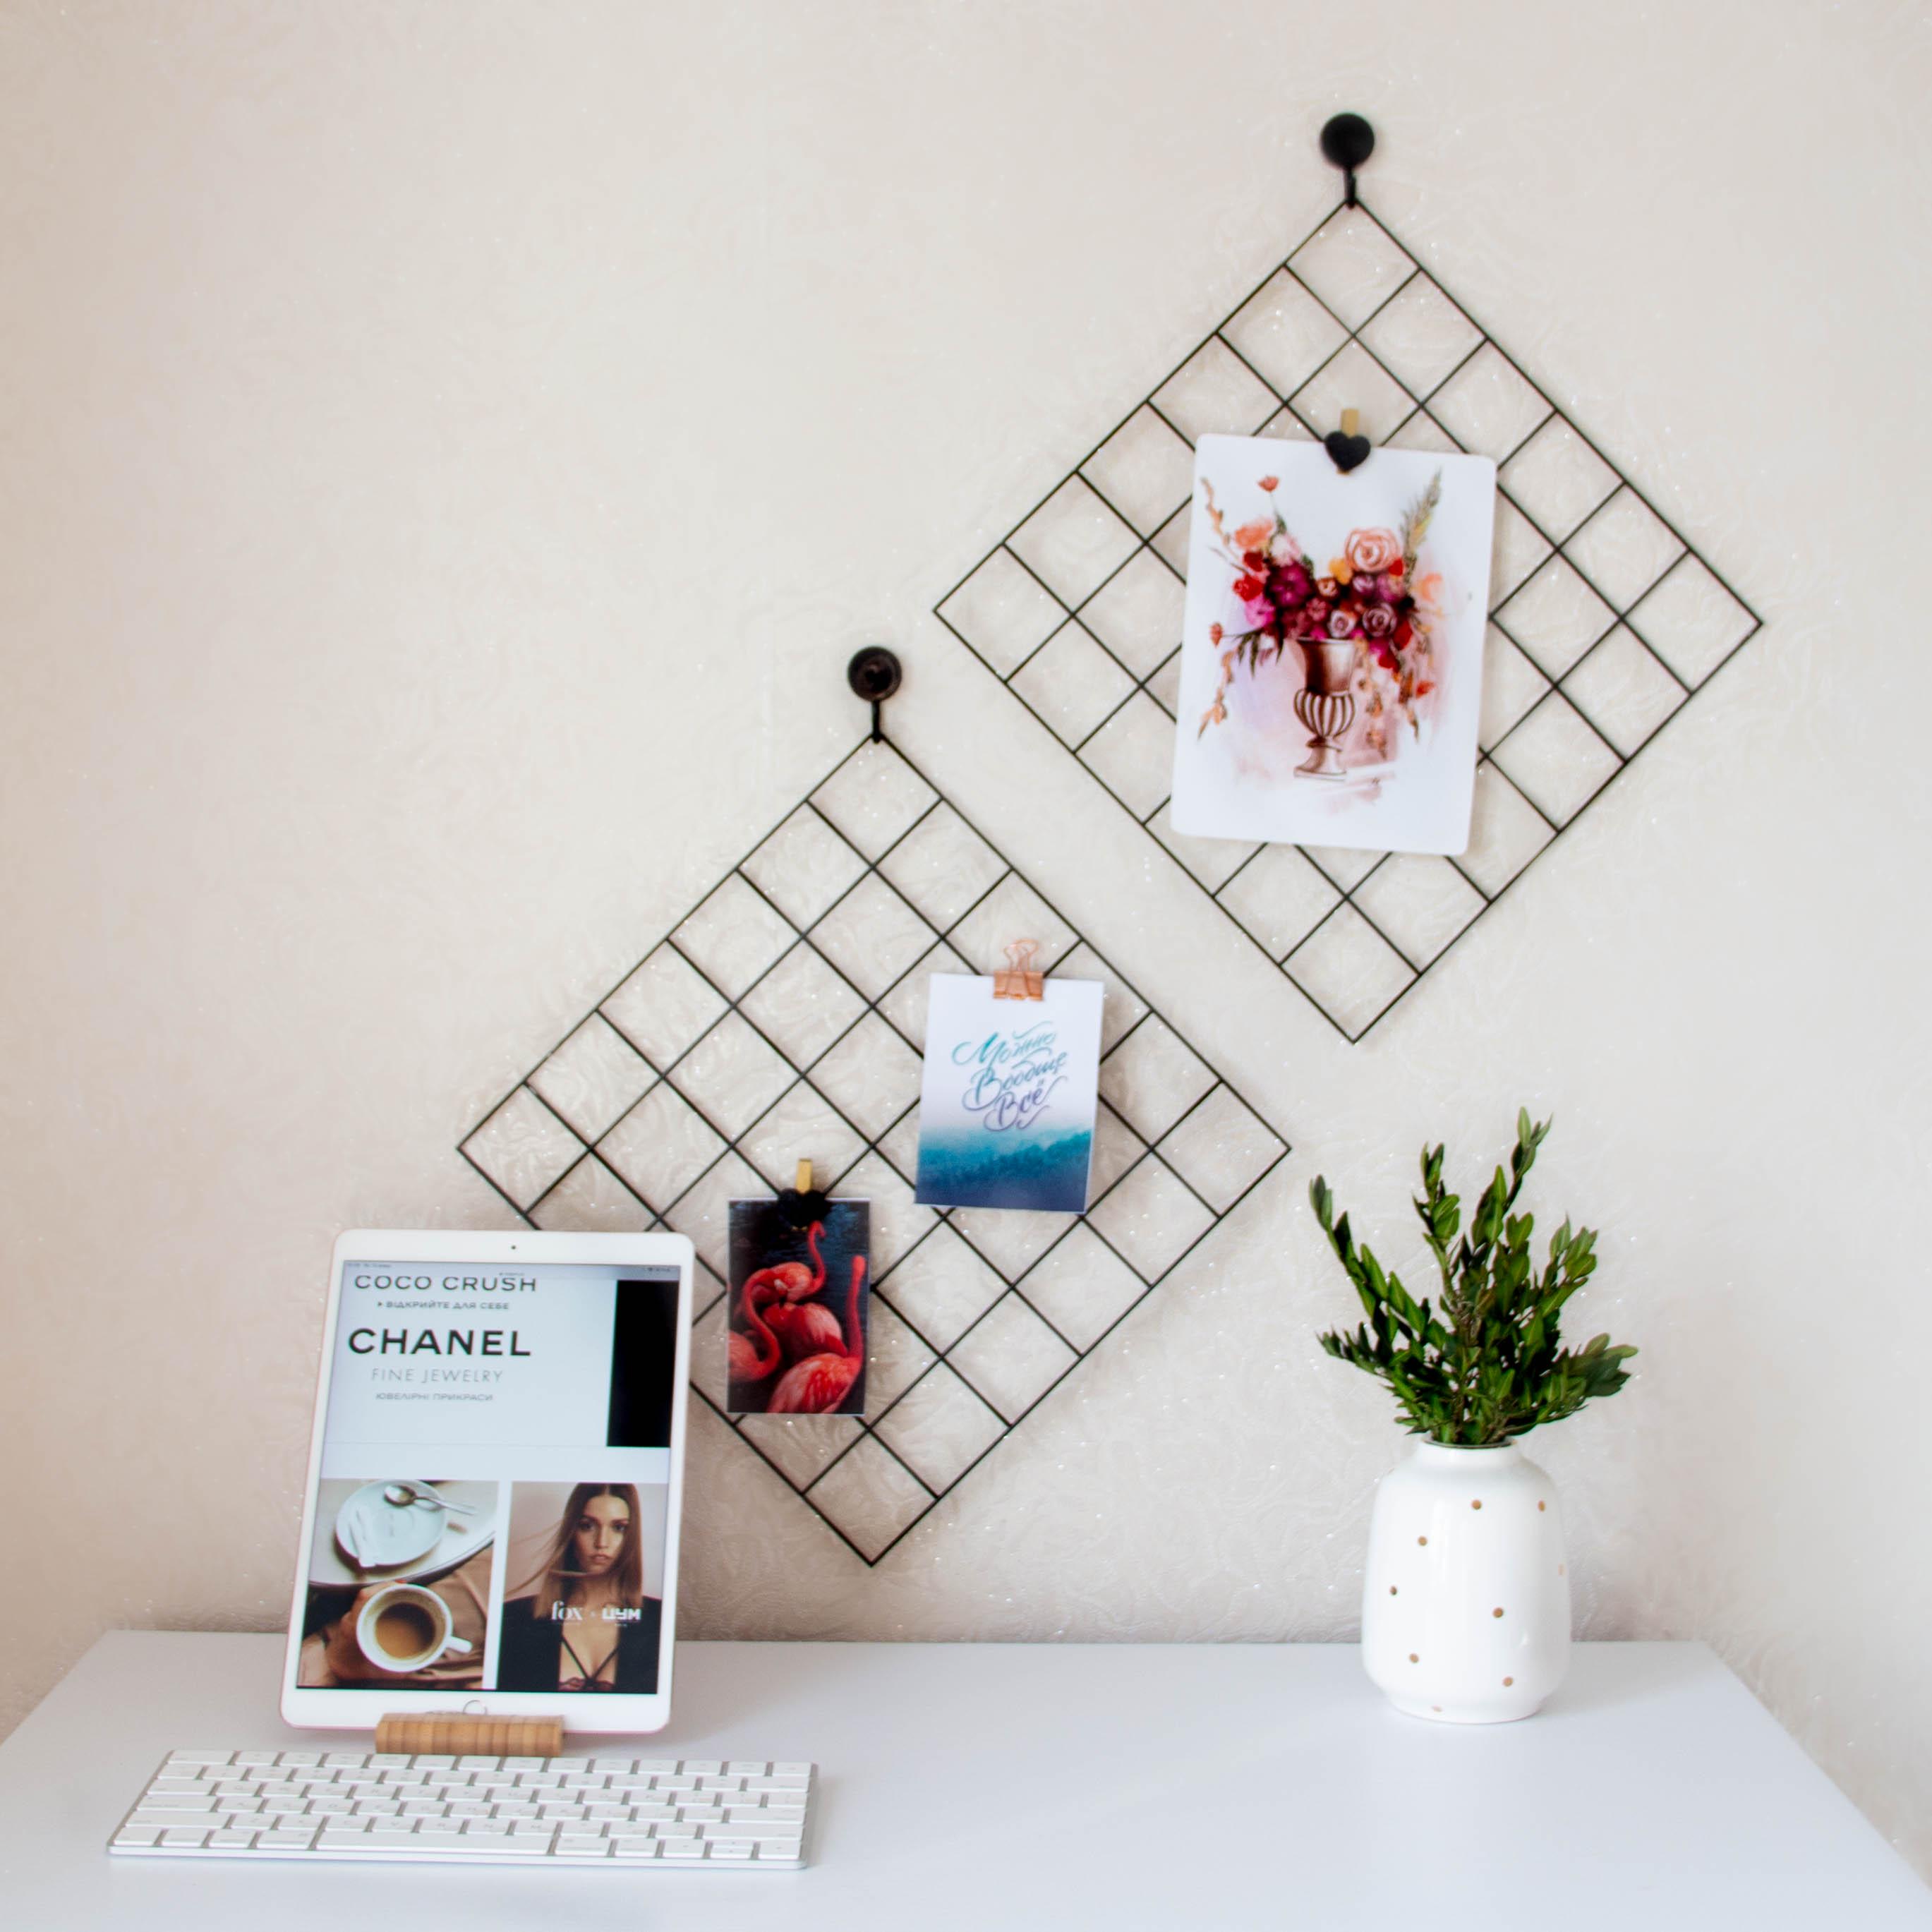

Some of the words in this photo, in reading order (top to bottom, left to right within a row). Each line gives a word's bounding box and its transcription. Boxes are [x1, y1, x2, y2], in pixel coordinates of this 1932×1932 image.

[354, 1275, 433, 1291] COCO
[442, 1276, 537, 1293] CRUSH
[386, 1300, 450, 1310] ВІДКРИЙТЕ
[452, 1302, 476, 1311] ДЛЯ
[480, 1302, 510, 1311] СЕБЕ
[348, 1327, 531, 1357] CHANEL
[371, 1368, 414, 1382] FINE
[422, 1370, 503, 1384] JEWELRY
[375, 1392, 430, 1401] ЮВЕЛІРНІ
[433, 1393, 494, 1402] ПРИКРАСИ
[551, 1600, 584, 1621] fox
